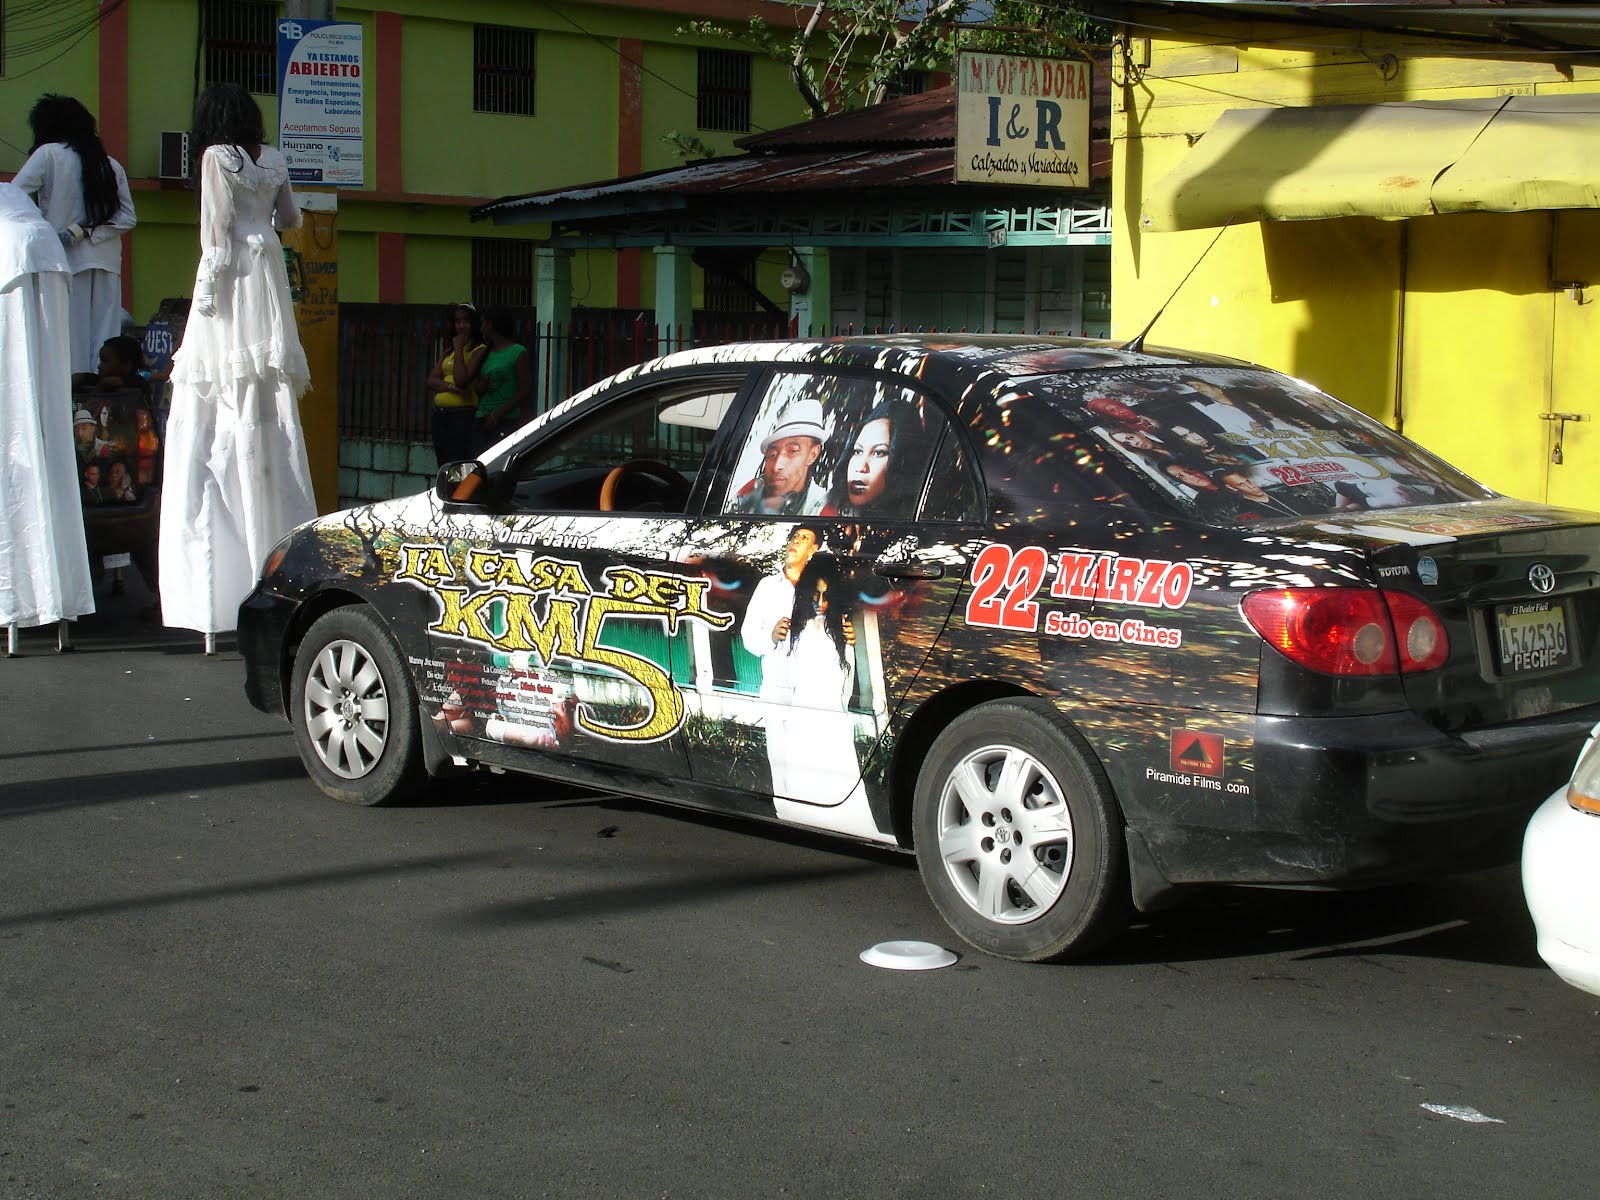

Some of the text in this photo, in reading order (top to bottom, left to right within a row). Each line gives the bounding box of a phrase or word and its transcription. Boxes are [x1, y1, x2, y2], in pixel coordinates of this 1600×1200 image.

[307, 52, 359, 63] YA ESTAMOS
[290, 61, 360, 78] ABIERTO
[287, 87, 361, 98] Emergencia, Imagenes
[310, 79, 361, 89] Internamientos,
[295, 97, 361, 107] Estudios Especiales,
[324, 107, 361, 116] Laboratorio
[283, 122, 361, 134] Aceptamos Seguros
[986, 96, 1066, 151] I & R
[283, 141, 324, 150] Humano
[971, 151, 1079, 178] Calzados y Variedades
[479, 529, 494, 543] de
[498, 529, 542, 546] Omar
[542, 529, 597, 549] Javier
[1378, 565, 1411, 578] TOYOTA
[396, 546, 735, 630] LA CASA DEL
[966, 543, 1193, 632] 22 MARZO
[1045, 611, 1182, 648] Solo en Cines
[1513, 649, 1559, 671] PECHE
[1146, 768, 1191, 786] Piramide
[1193, 775, 1222, 790] Films
